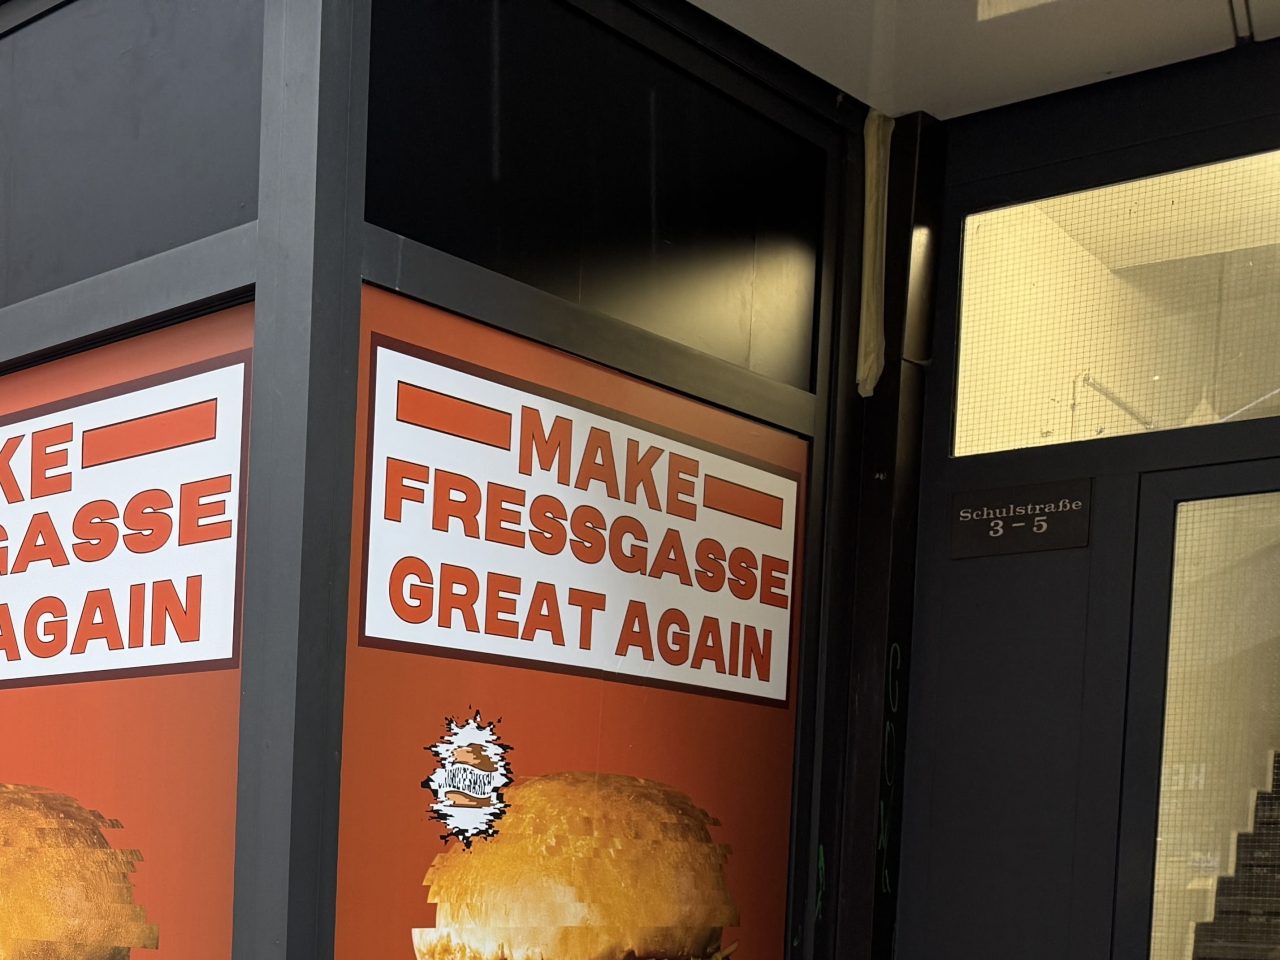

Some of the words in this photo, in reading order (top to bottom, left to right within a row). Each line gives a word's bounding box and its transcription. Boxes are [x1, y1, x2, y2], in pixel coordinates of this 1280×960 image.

[518, 404, 700, 523] MAKE
[959, 498, 1083, 521] Schulstraße
[383, 455, 790, 611] FRESSGASSE
[989, 519, 1004, 538] 3
[1032, 516, 1048, 534] 5
[387, 555, 607, 652] GREAT
[614, 599, 773, 683] AGAIN
